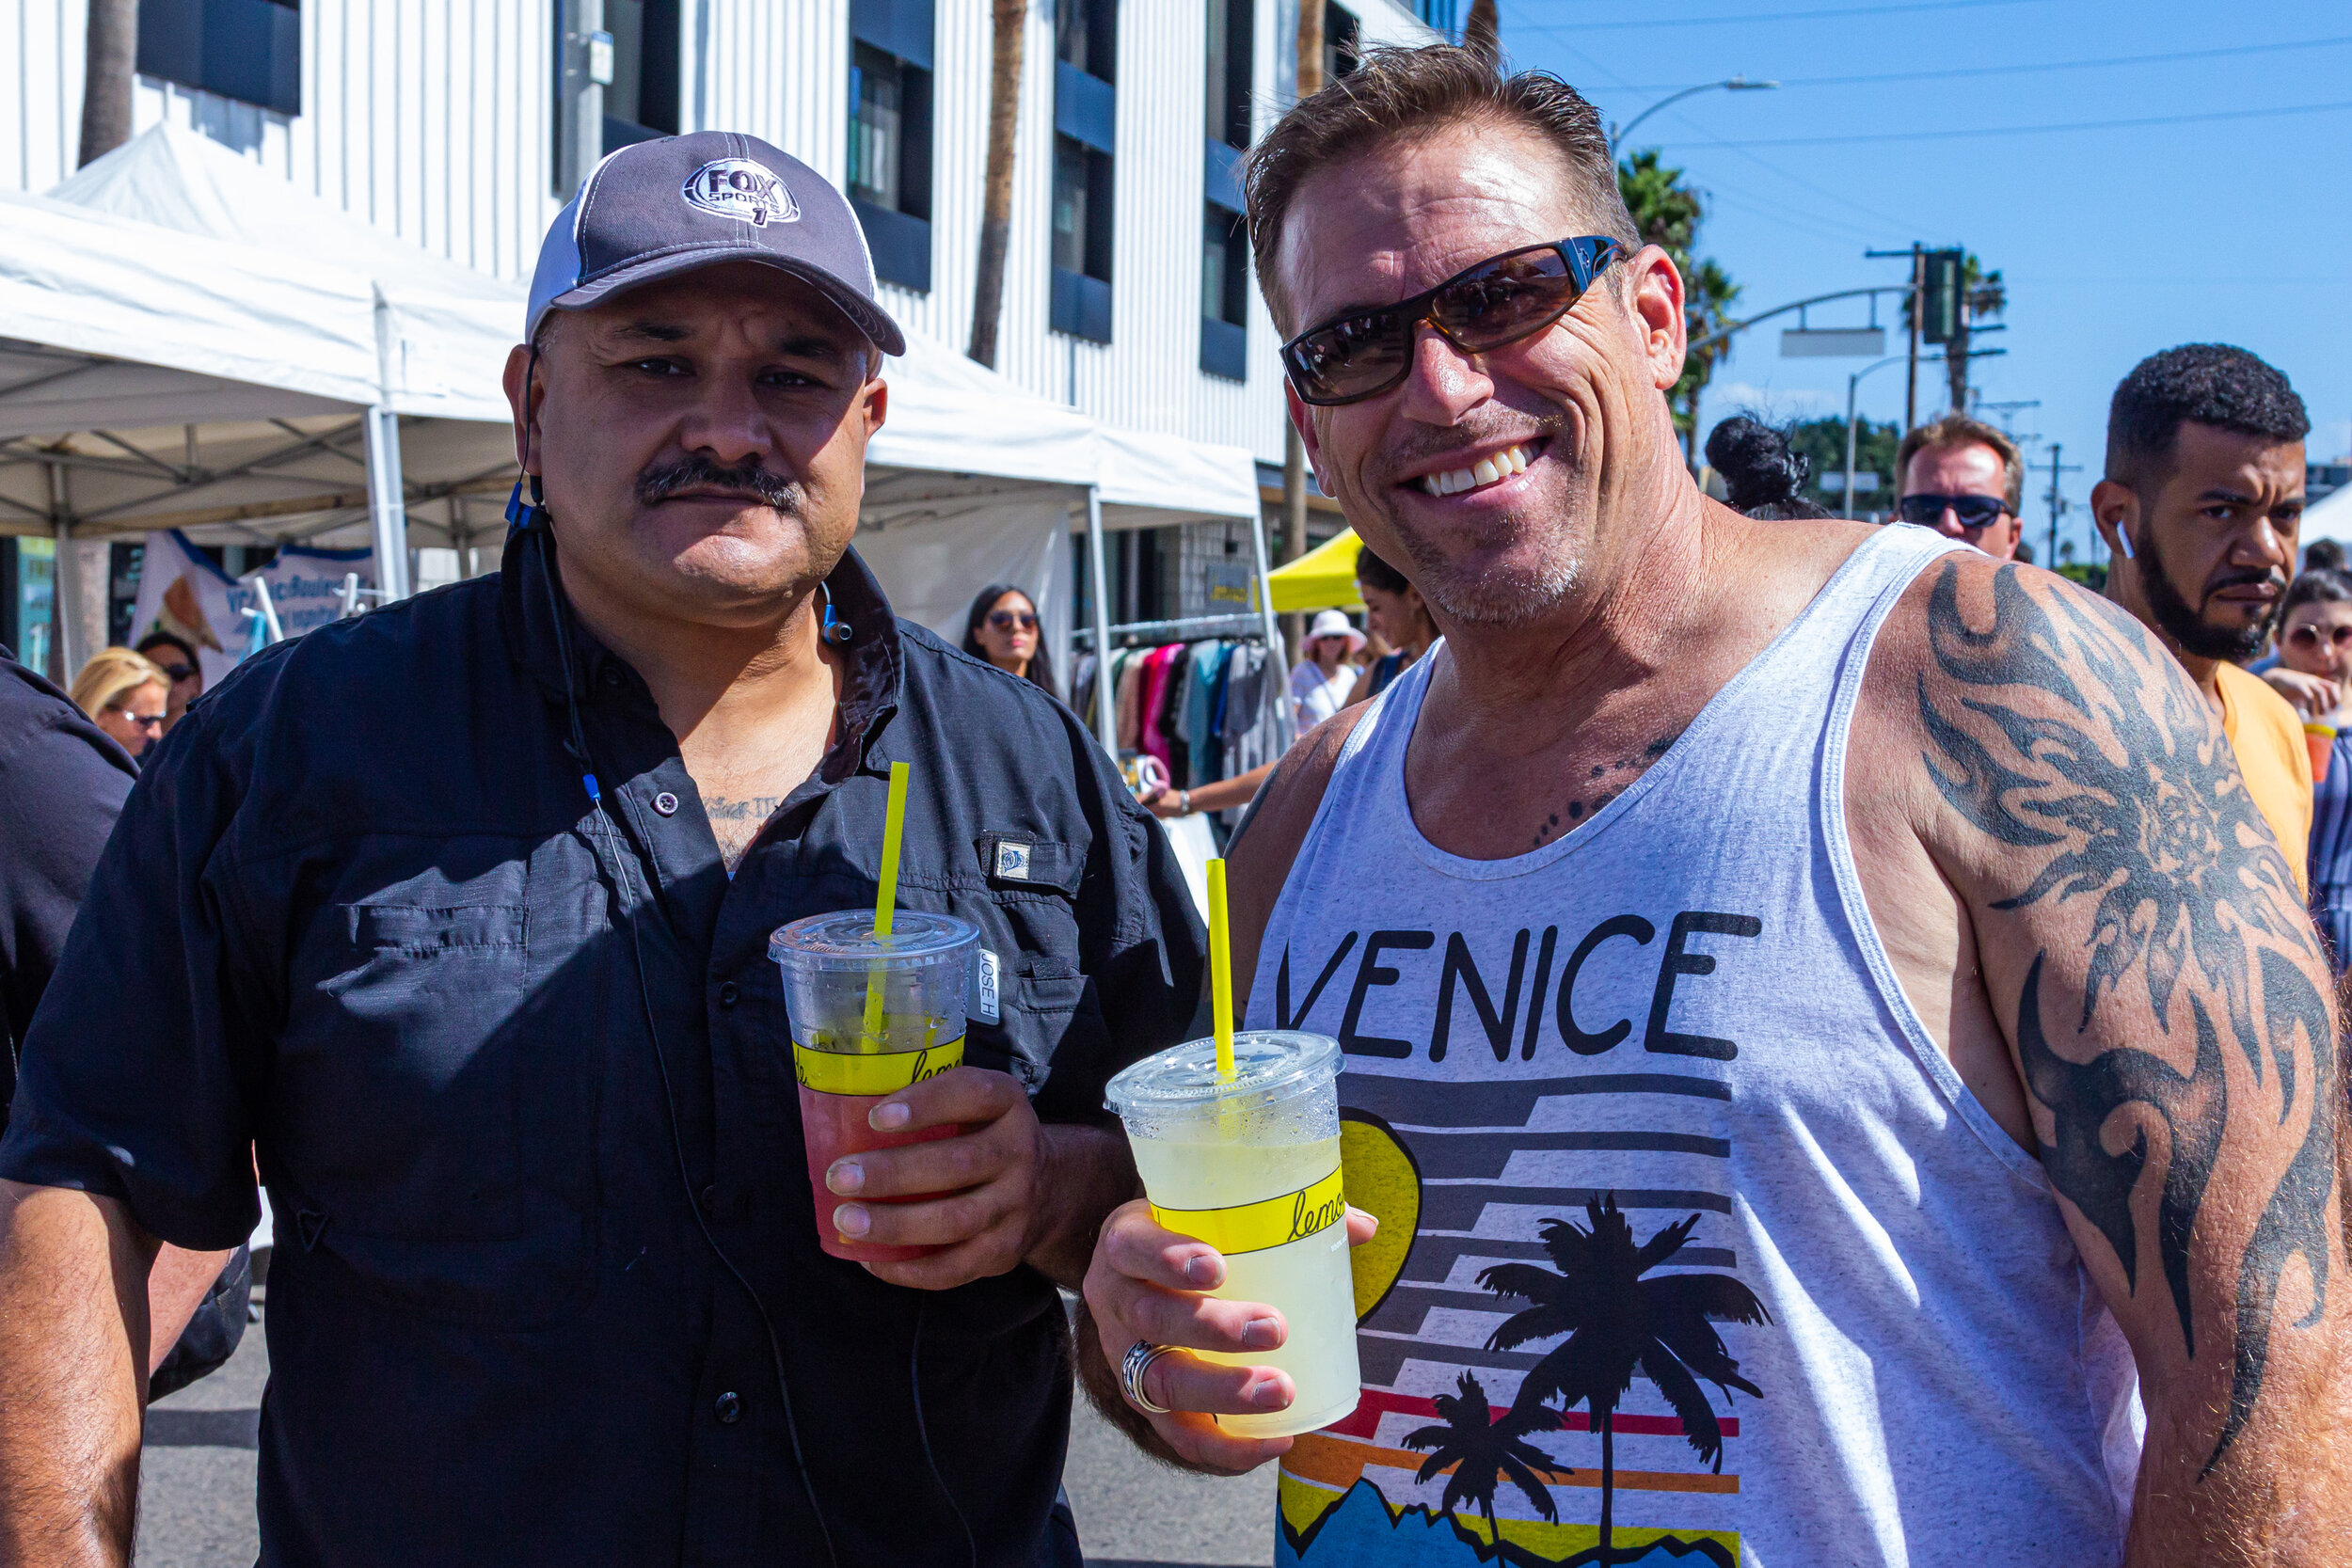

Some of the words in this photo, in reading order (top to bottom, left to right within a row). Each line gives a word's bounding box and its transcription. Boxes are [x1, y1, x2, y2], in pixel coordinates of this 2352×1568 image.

[708, 169, 778, 204] FOX
[708, 192, 780, 214] SPORTS
[753, 207, 768, 226] 1
[981, 953, 994, 999] JOSE
[1275, 911, 1763, 1063] VENICE
[982, 1003, 995, 1015] H
